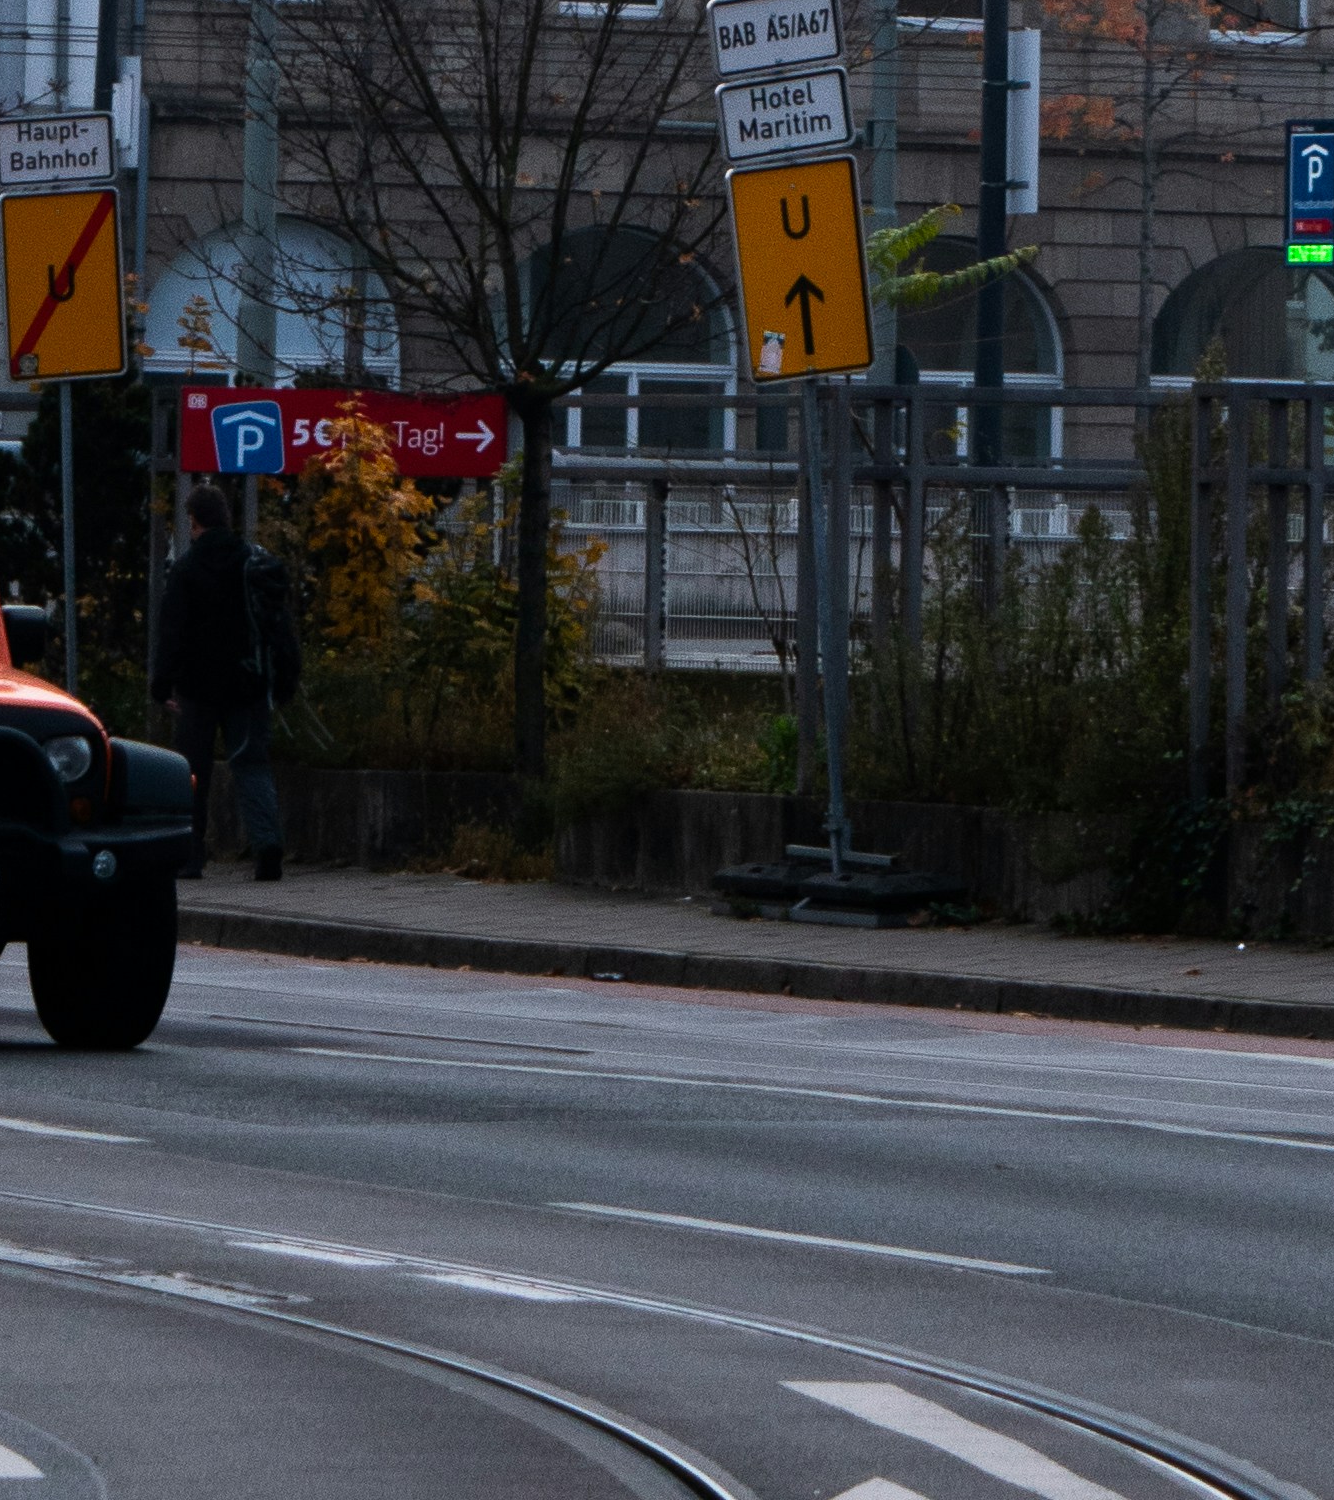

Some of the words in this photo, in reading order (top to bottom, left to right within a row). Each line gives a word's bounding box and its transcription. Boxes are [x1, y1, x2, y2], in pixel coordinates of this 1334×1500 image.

[719, 21, 756, 50] BAB
[767, 9, 829, 42] A5/A67
[750, 81, 815, 112] Hotel
[18, 121, 88, 143] Haupt-
[739, 111, 831, 142] Maritim
[10, 147, 99, 171] Bahnhof
[1308, 156, 1323, 193] P
[780, 194, 810, 240] U
[48, 264, 75, 301] U
[237, 425, 264, 467] P
[292, 419, 333, 446] 5€
[392, 421, 445, 455] Tag!
